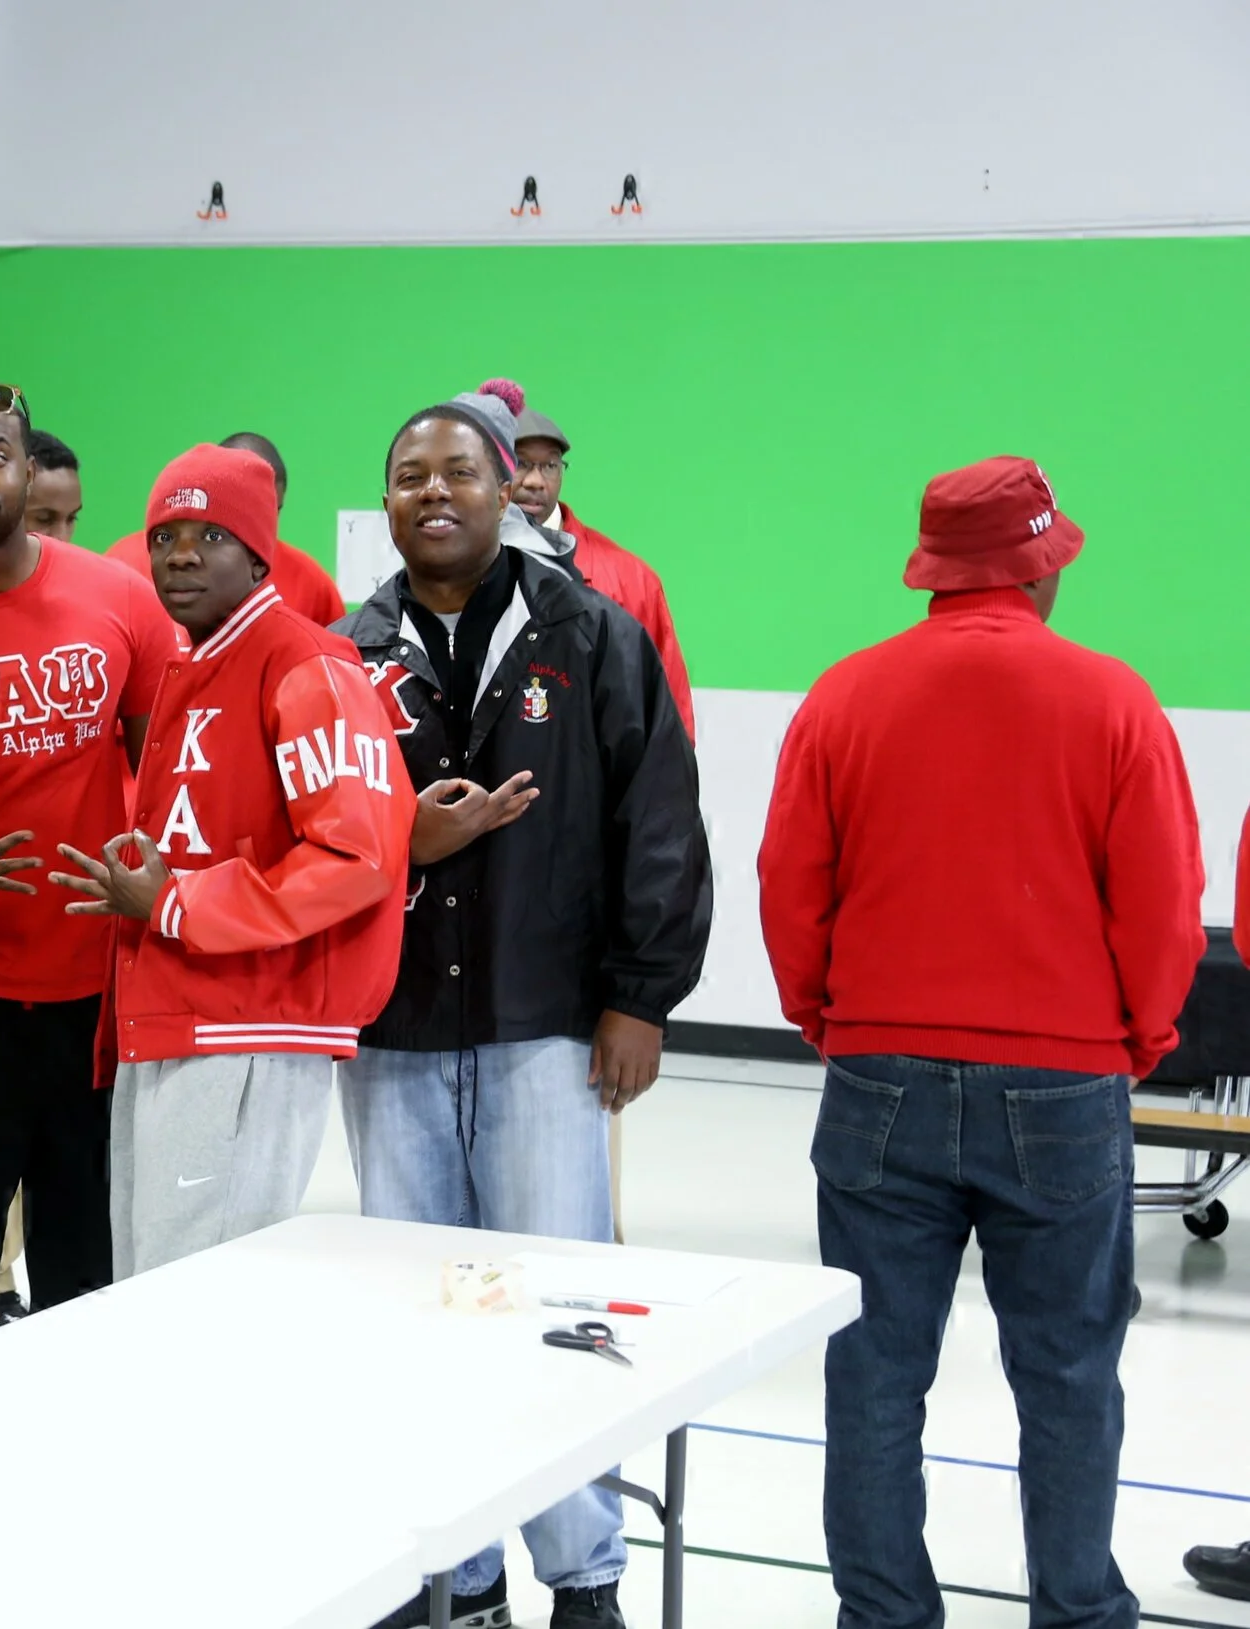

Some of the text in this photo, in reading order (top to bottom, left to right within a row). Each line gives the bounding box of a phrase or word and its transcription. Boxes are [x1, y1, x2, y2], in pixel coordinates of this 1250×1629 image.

[164, 496, 192, 504] NORTH
[177, 488, 192, 496] THE
[1029, 510, 1052, 535] 1911
[2, 728, 66, 757] Alpha
[75, 720, 103, 746] Psi
